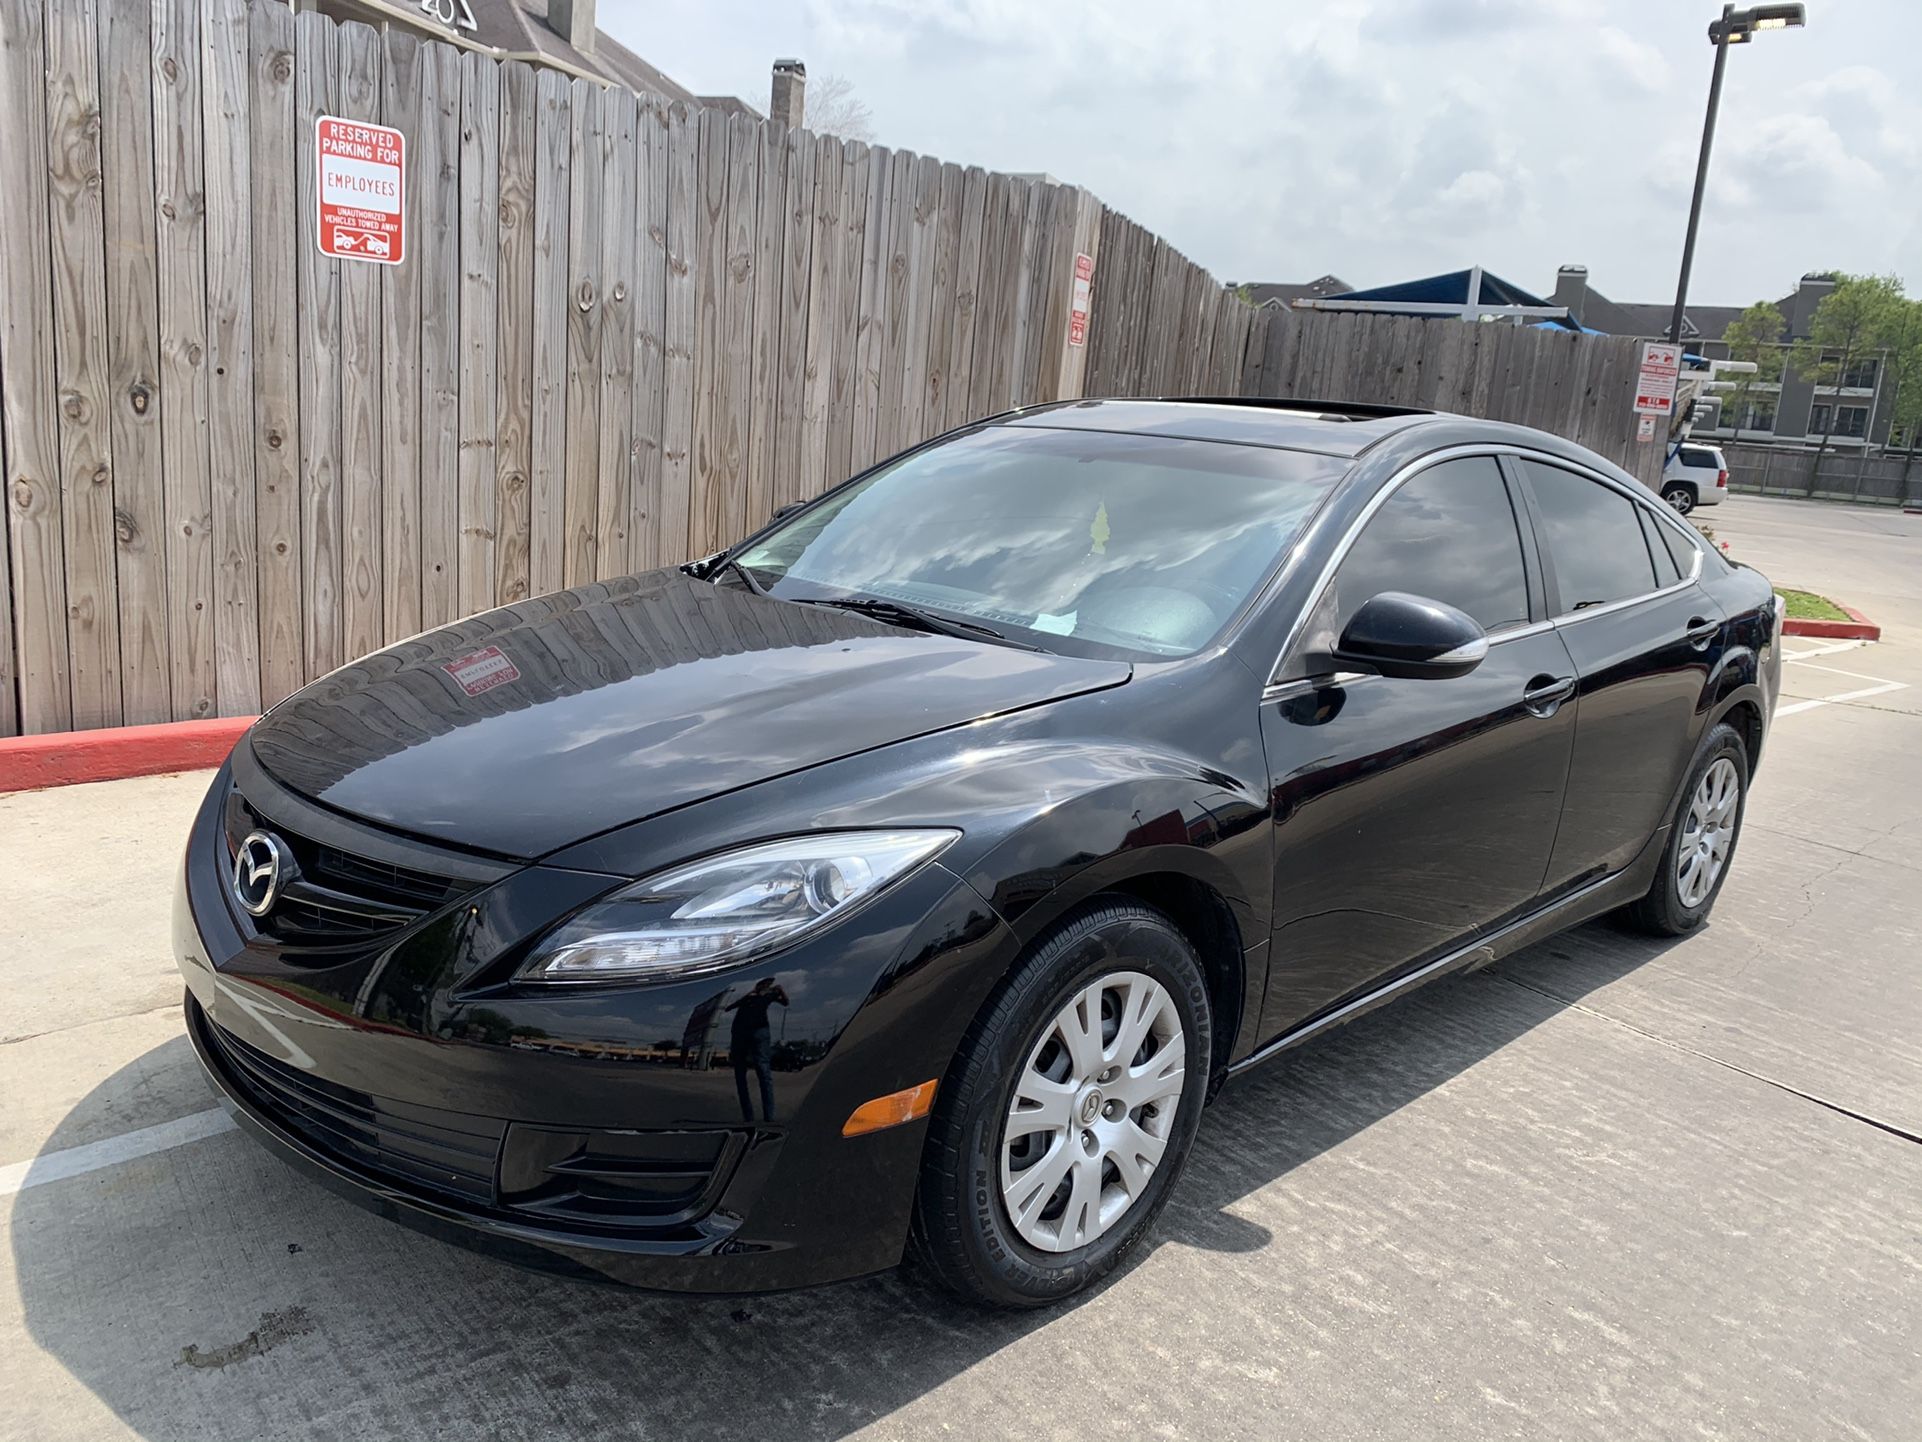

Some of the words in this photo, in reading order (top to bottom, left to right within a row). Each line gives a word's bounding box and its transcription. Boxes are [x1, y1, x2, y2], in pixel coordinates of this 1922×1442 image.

[330, 124, 394, 148] RESERVED
[322, 137, 372, 159] PARKING
[377, 147, 399, 164] FOR
[328, 172, 395, 197] EMPLOYEES
[324, 214, 356, 227] VEHICLES
[358, 219, 380, 230] TOWED
[381, 222, 398, 232] AWAY
[337, 207, 387, 222] UNAUTHORIZED
[975, 1170, 1007, 1264] EDITION
